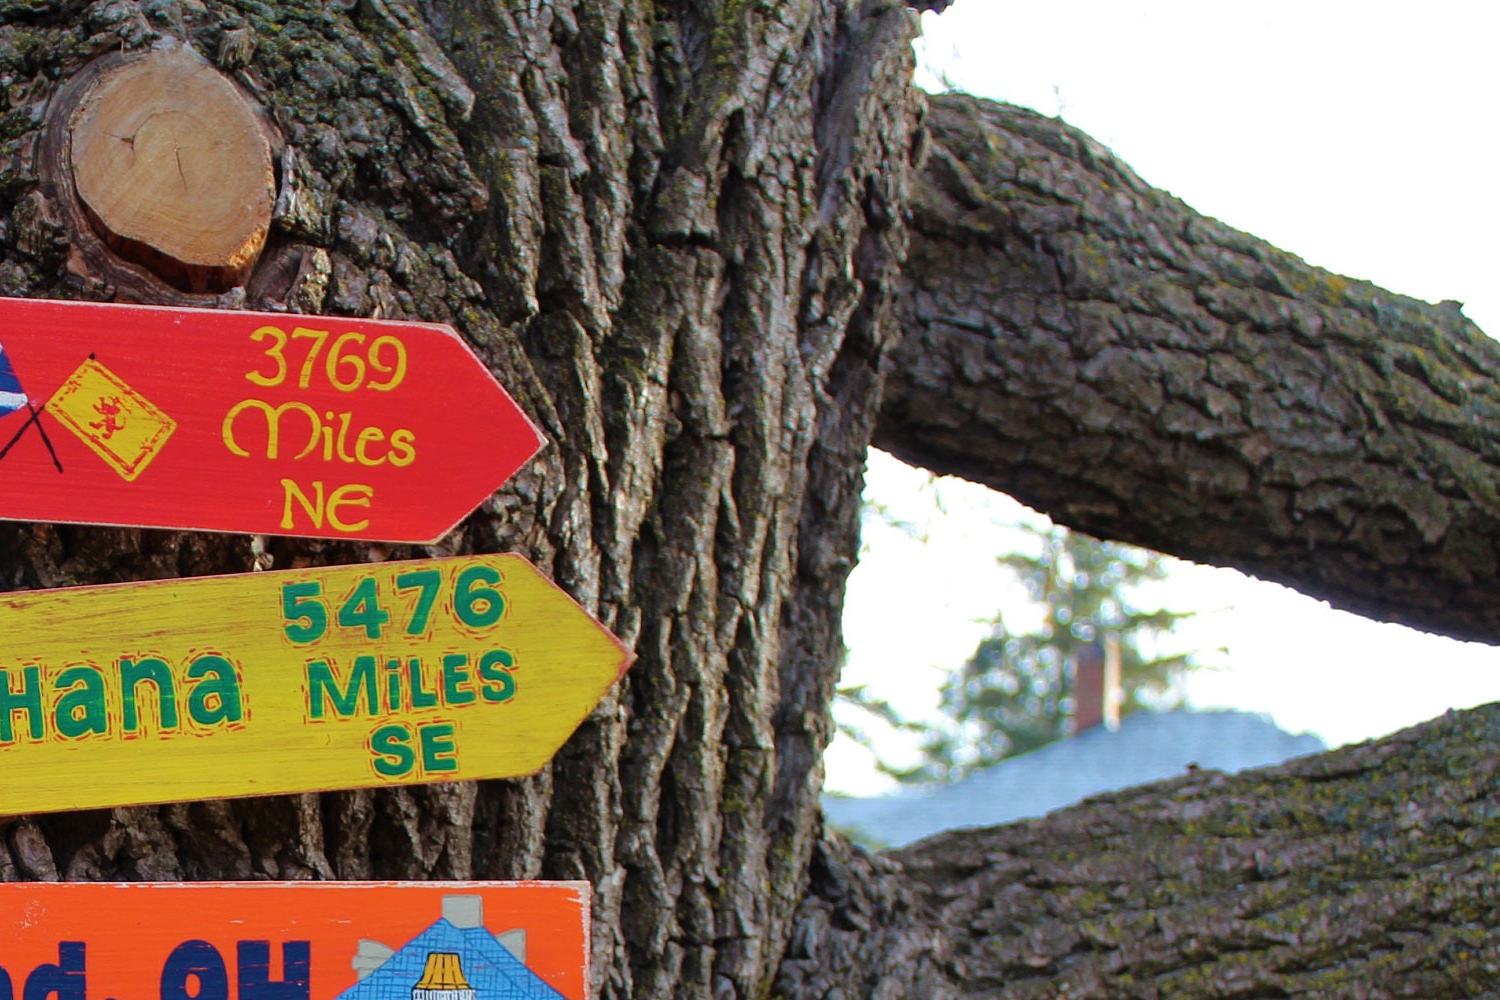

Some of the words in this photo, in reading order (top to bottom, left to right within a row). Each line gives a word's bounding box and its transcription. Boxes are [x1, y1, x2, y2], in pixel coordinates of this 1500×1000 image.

[245, 325, 408, 393] 3769
[222, 398, 416, 467] Miles
[280, 479, 374, 532] NE
[281, 565, 505, 643] 5476
[370, 724, 458, 777] SE
